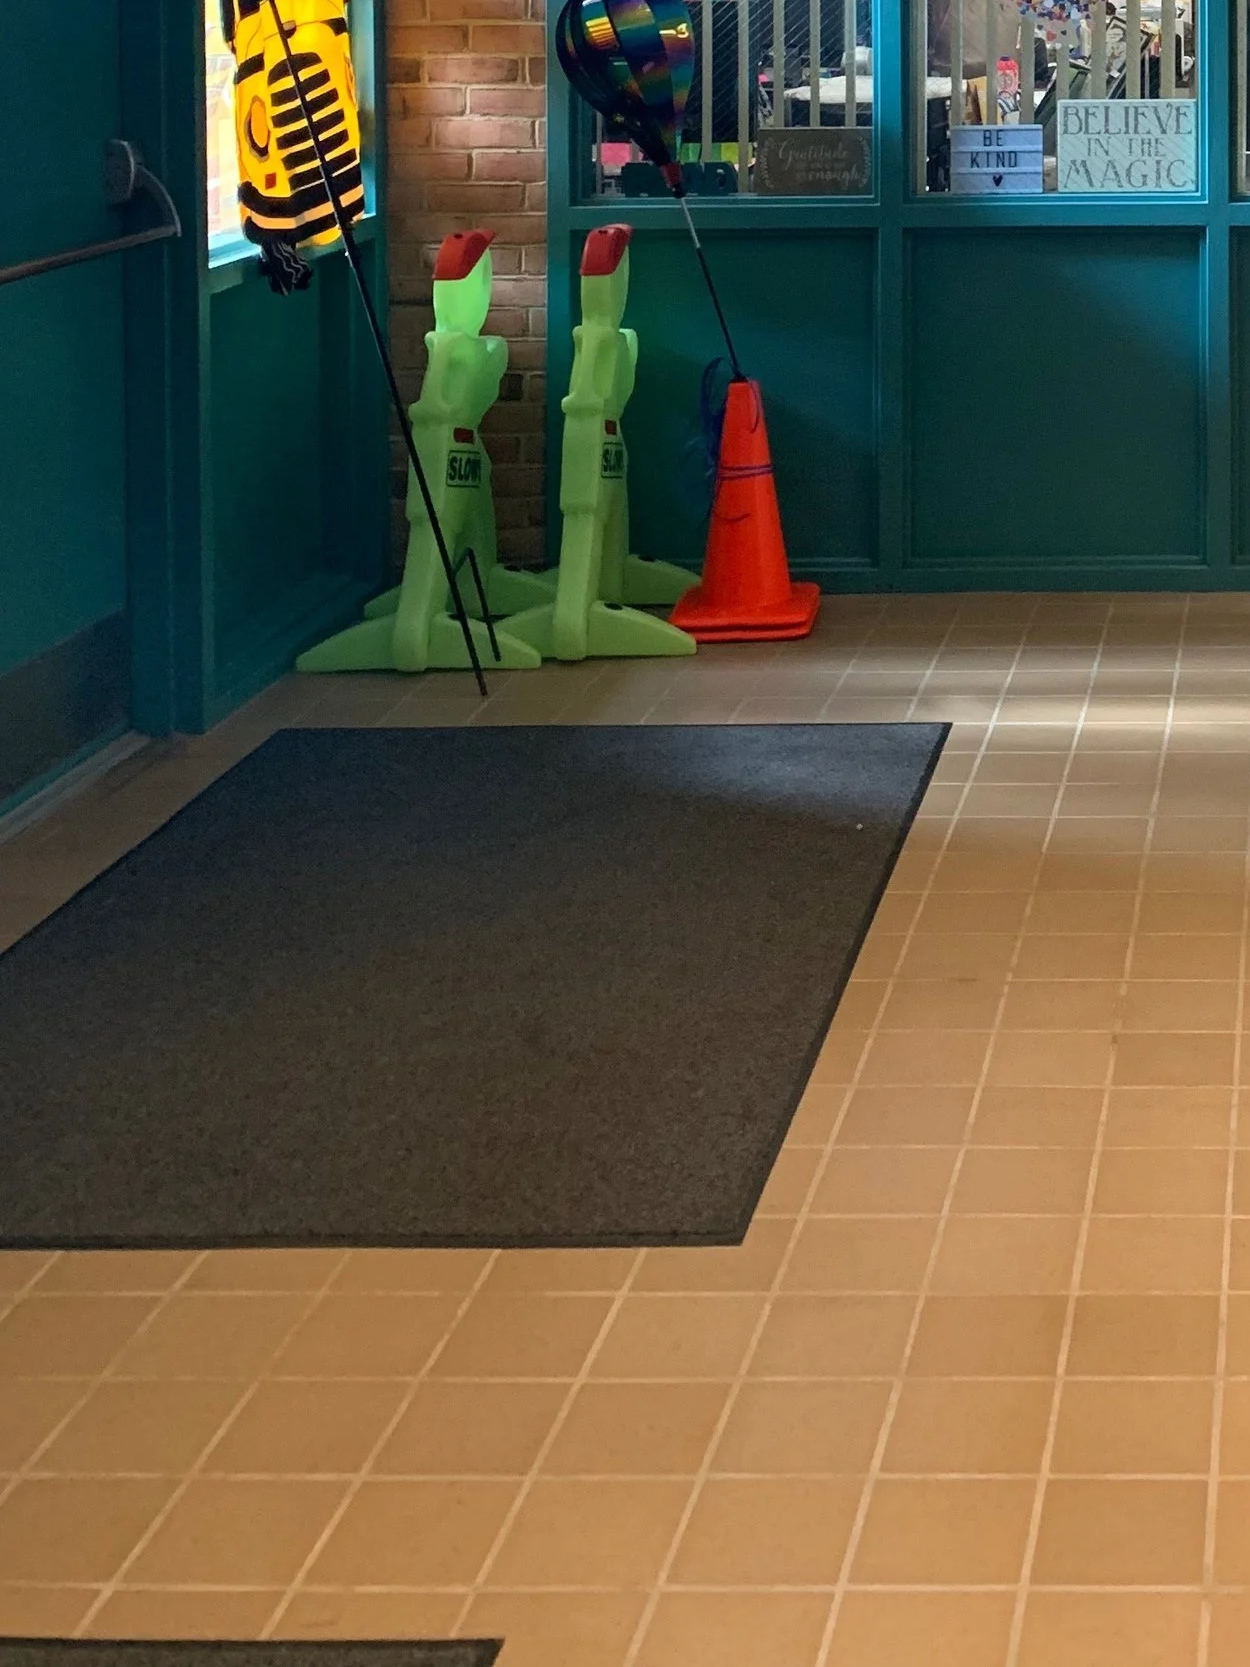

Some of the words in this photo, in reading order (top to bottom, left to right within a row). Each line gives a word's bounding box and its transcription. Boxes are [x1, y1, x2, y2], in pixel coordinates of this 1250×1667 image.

[1061, 103, 1193, 135] BELIEVE
[982, 129, 1004, 147] BE
[1086, 137, 1110, 157] IN
[1127, 137, 1167, 157] THE
[970, 152, 1018, 169] KIND
